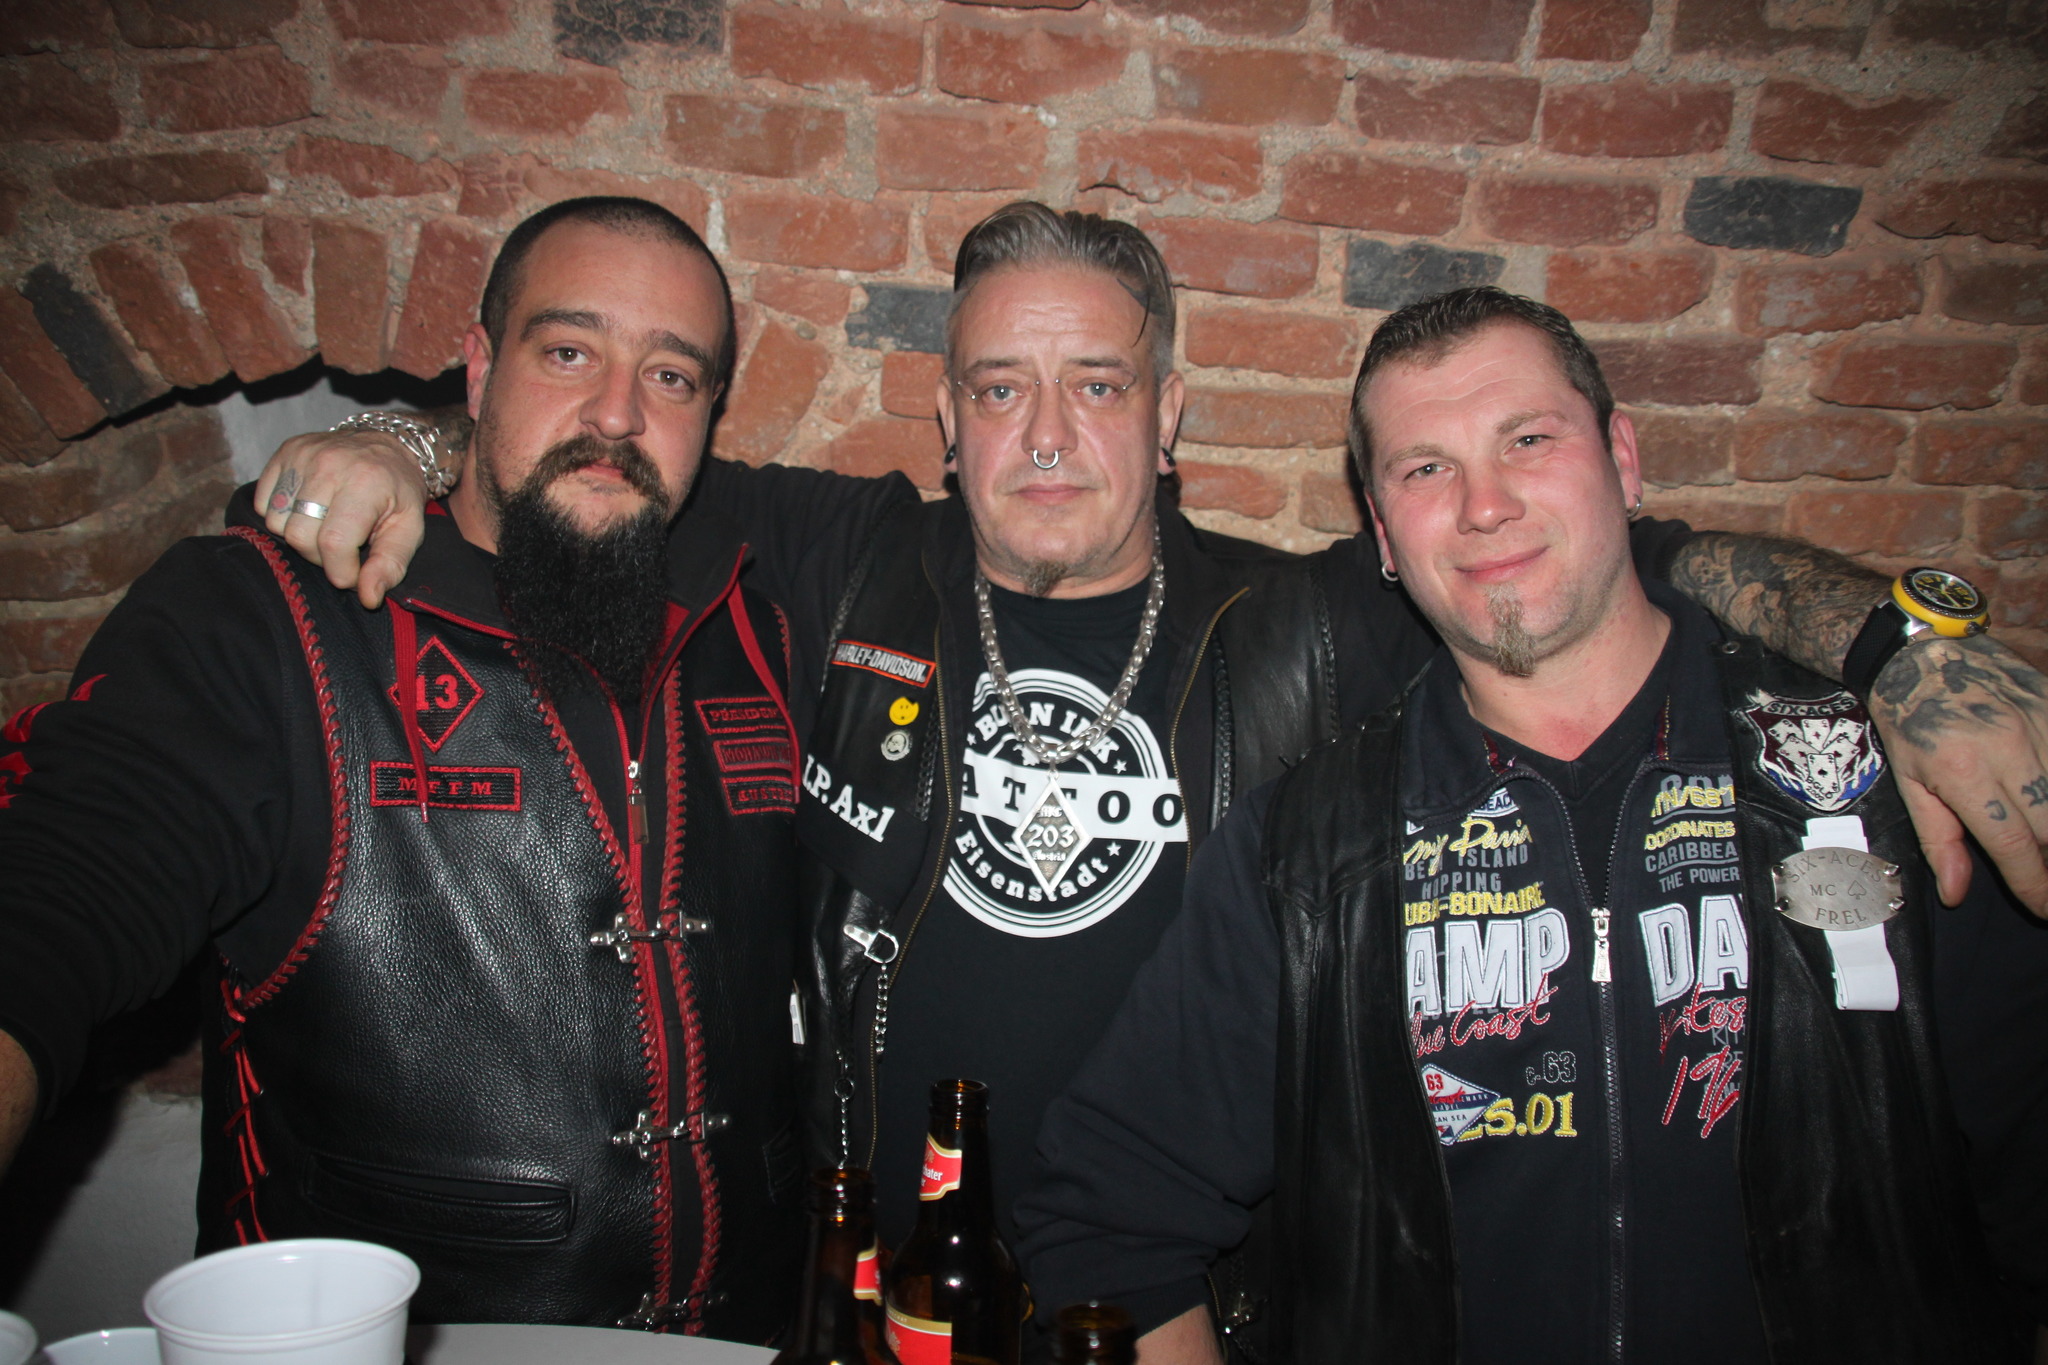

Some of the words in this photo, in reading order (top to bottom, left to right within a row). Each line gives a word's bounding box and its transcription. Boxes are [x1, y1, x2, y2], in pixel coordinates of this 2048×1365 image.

[416, 674, 460, 711] 13
[1767, 696, 1857, 717] SIX-ACES
[974, 702, 1055, 742] BUN
[1026, 823, 1076, 849] 203
[1457, 844, 1529, 870] ISLAND
[1644, 841, 1738, 873] CARIBBEA
[1787, 850, 1883, 884] SIX-ACES
[1421, 871, 1503, 901] HOPPING
[1658, 871, 1684, 893] THE
[1689, 866, 1741, 884] POWER
[1809, 883, 1838, 897] MC
[1815, 906, 1868, 926] FREL
[1400, 907, 1570, 1019] AMP
[1450, 972, 1560, 1047] Coast
[1425, 1073, 1445, 1091] 63
[1450, 1113, 1468, 1122] SEA
